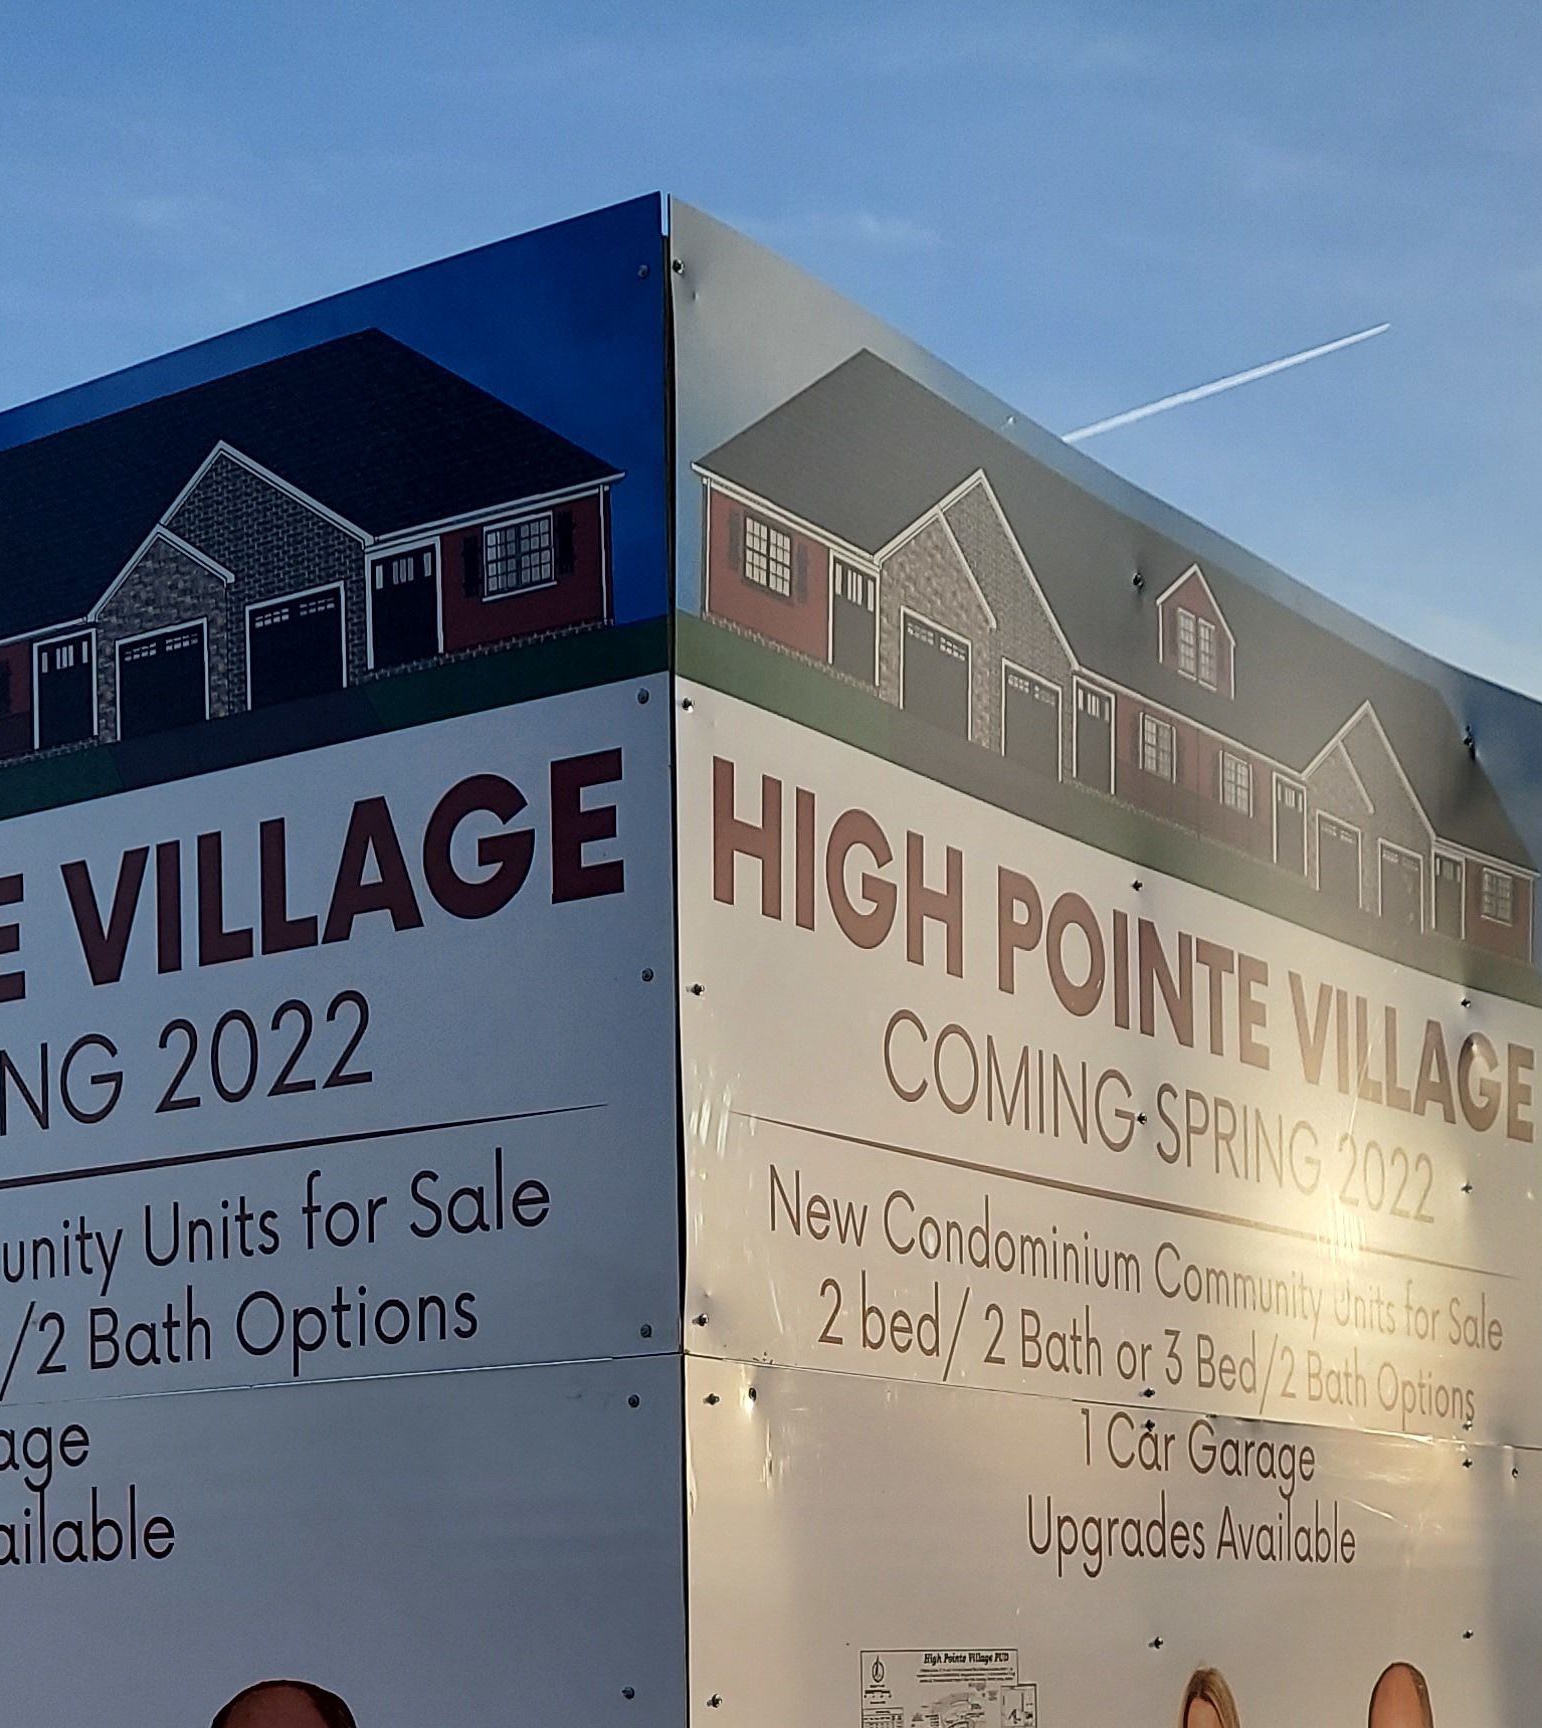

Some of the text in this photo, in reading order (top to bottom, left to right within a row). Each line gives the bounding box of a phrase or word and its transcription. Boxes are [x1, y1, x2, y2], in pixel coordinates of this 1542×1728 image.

[61, 746, 625, 985] VILLAGE
[712, 755, 1537, 1143] HIGH POINTE VILLAGE
[158, 989, 373, 1116] 2022
[883, 1008, 1438, 1225] COMING SPRING 2022
[143, 1196, 282, 1268] Units
[302, 1170, 387, 1249] for
[410, 1147, 551, 1239] Sale
[768, 1162, 1504, 1352] New Condominium Community Units for Sale
[89, 1284, 213, 1369] Bath
[235, 1286, 479, 1376] Options
[819, 1278, 844, 1346] 2
[983, 1303, 1006, 1365] 2
[1020, 1304, 1103, 1379] Bath
[1117, 1338, 1153, 1383] or
[1164, 1328, 1182, 1386] 3
[1307, 1346, 1369, 1409] Bath
[1378, 1360, 1476, 1430] Options
[1080, 1408, 1316, 1499] 1 Car Garage
[1026, 1489, 1357, 1578] Upgrades Available
